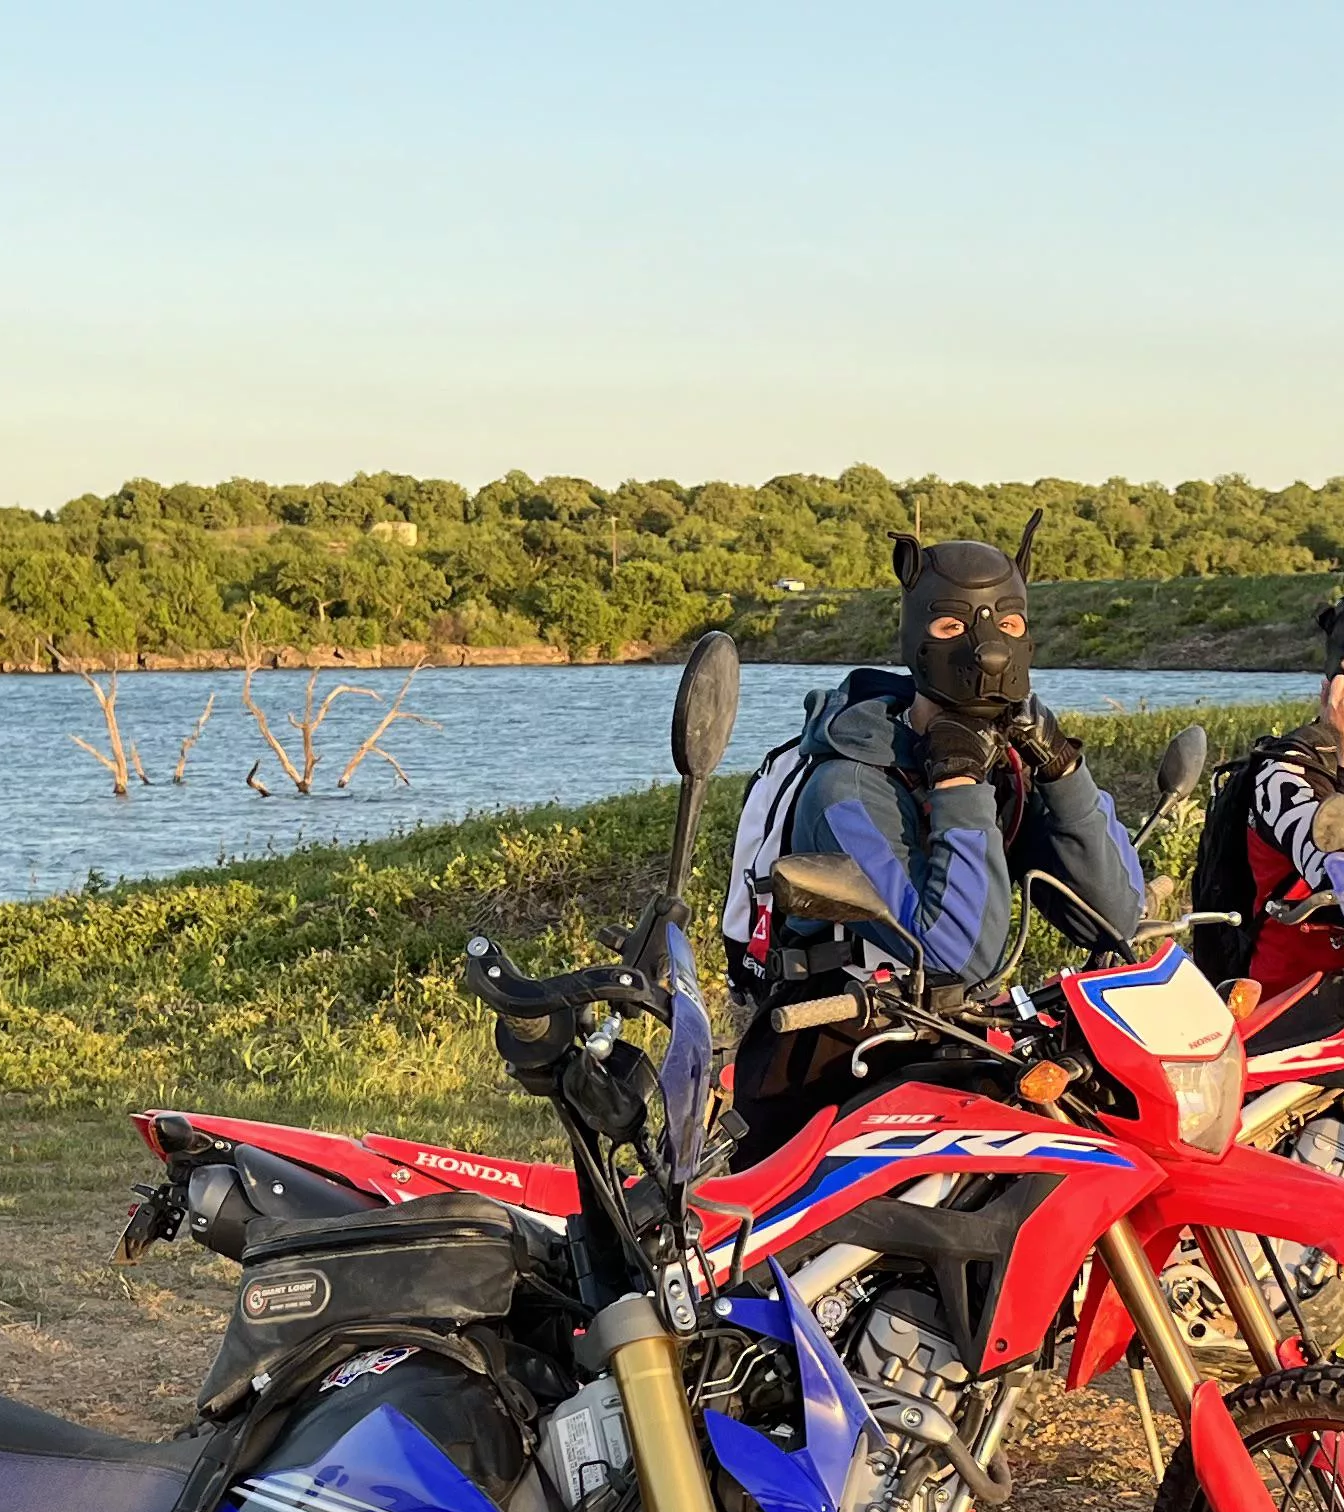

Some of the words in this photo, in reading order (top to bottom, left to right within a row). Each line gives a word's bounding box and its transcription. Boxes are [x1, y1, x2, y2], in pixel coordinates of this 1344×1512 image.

[1188, 1031, 1223, 1050] HONDA
[826, 1129, 1119, 1157] CRF
[414, 1151, 524, 1189] HONDA
